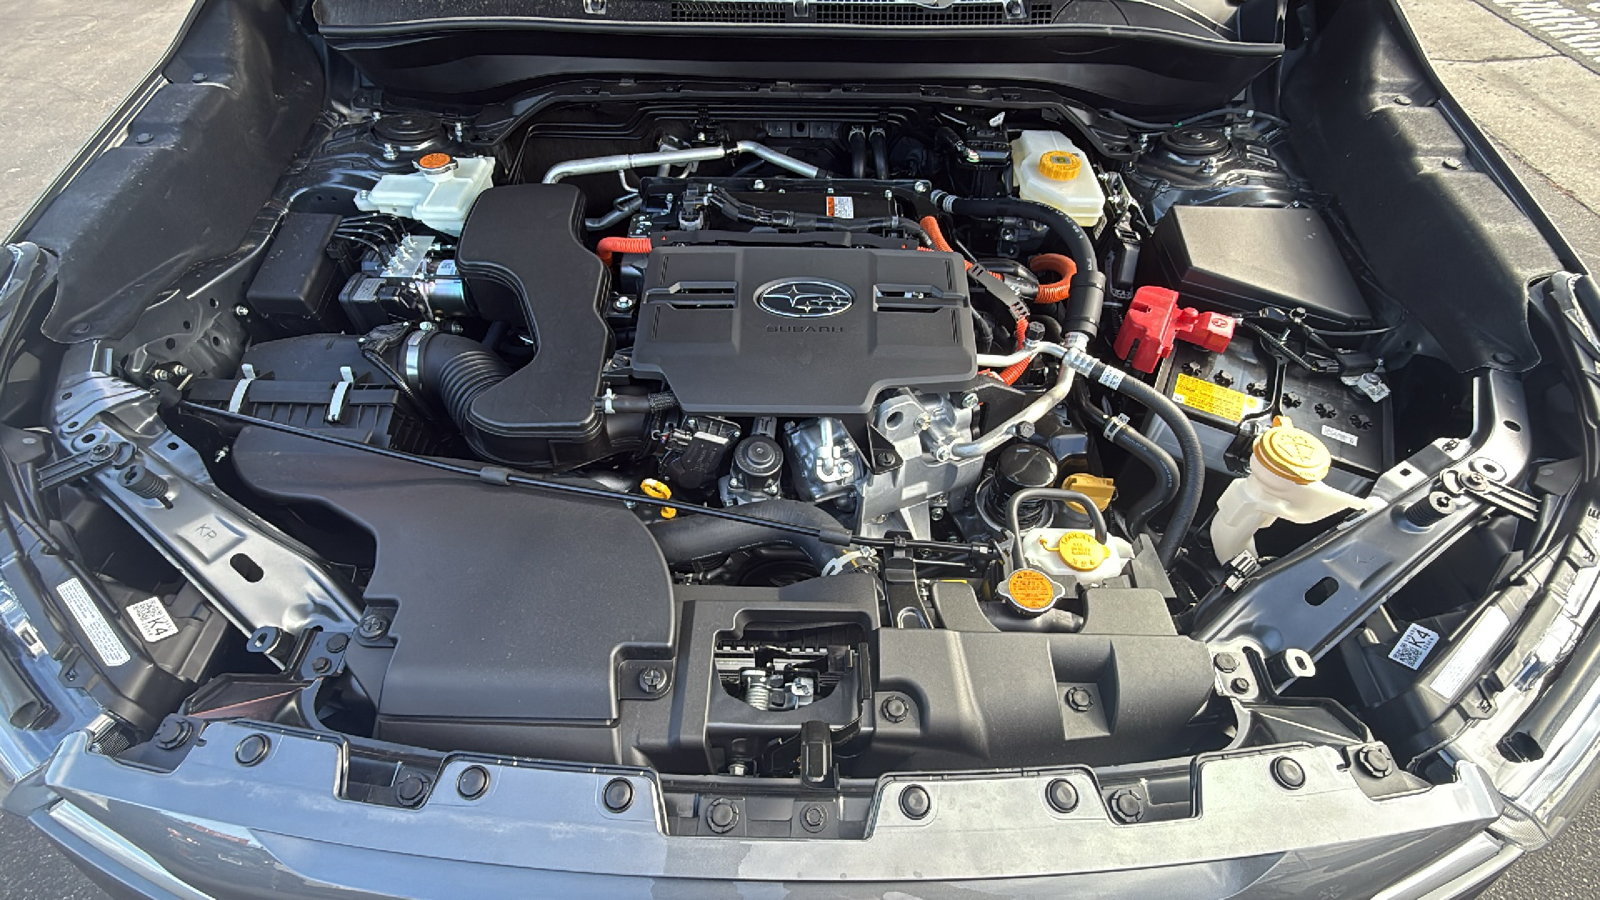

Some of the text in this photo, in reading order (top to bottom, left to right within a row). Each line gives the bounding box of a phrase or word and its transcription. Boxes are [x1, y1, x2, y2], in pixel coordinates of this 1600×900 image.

[766, 325, 843, 333] SUBARU
[195, 523, 218, 541] KR
[149, 617, 169, 636] K4
[1408, 629, 1431, 649] K4
